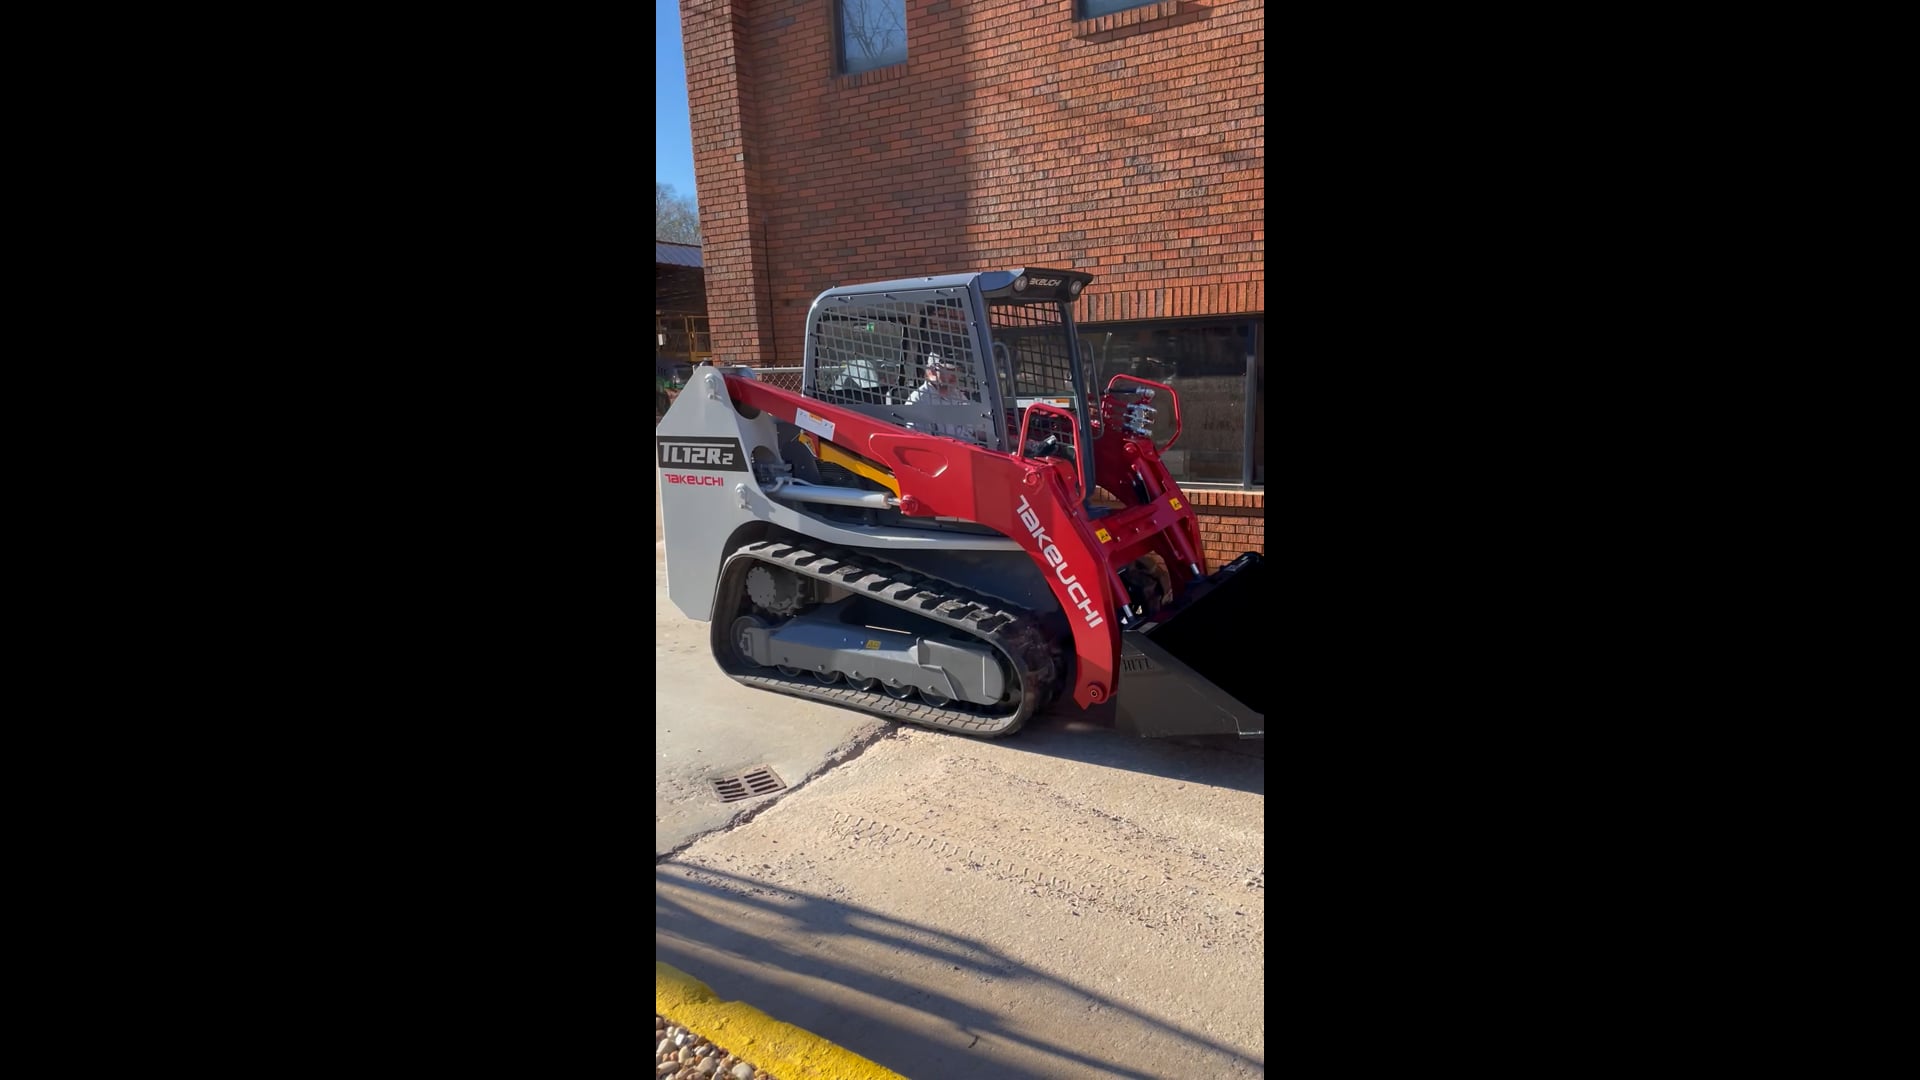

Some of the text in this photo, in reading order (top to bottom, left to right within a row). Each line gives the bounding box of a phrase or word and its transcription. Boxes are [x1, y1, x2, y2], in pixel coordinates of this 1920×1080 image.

[659, 441, 736, 465] TL12R2
[664, 473, 724, 487] TAKEUCHI
[1016, 495, 1104, 629] TAKEUCHI
